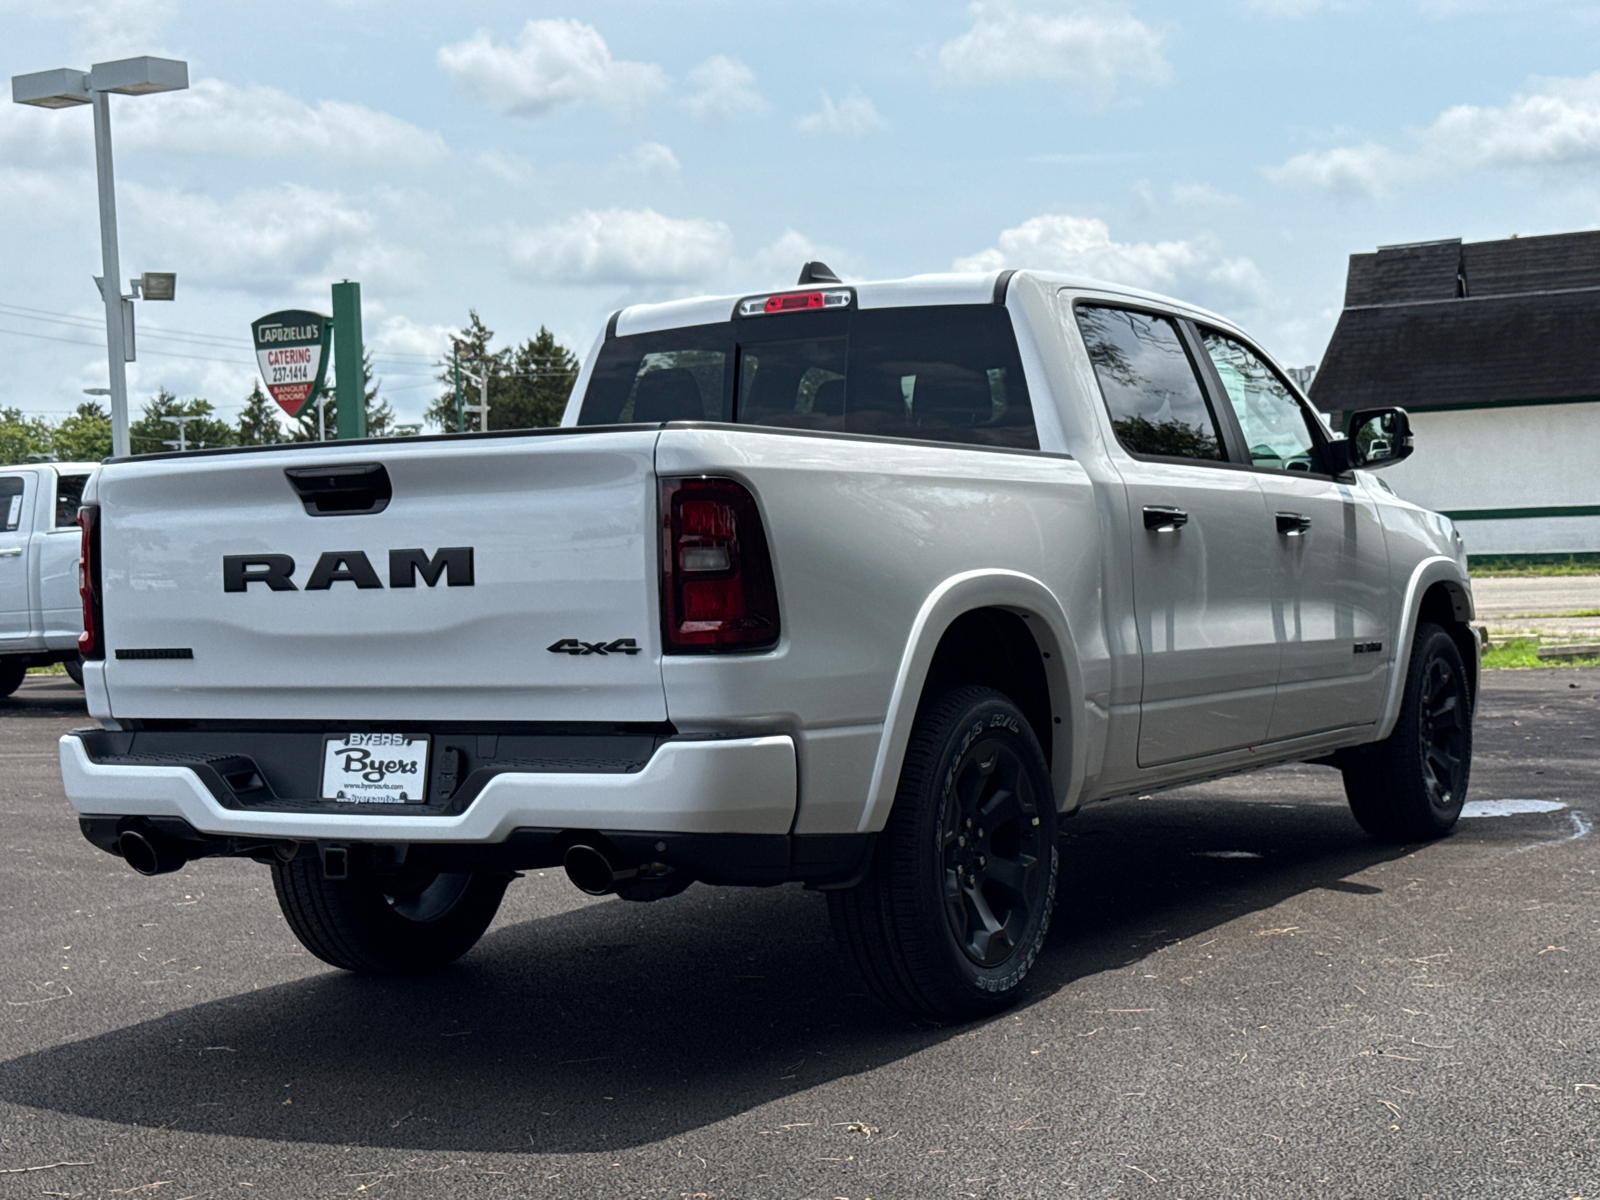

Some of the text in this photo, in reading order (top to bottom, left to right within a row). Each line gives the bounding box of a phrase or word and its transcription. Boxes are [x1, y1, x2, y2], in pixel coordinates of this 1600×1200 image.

[258, 323, 319, 343] CAPOZIELLO'S
[267, 348, 311, 366] CATERING
[273, 365, 308, 383] 237-1414
[273, 384, 308, 395] BANQUET
[278, 393, 306, 401] ROOMS
[222, 546, 475, 593] RAM
[546, 638, 642, 656] 4x4
[349, 733, 404, 746] BYERS
[334, 747, 418, 783] Byers
[343, 782, 404, 791] www.byersauto.com
